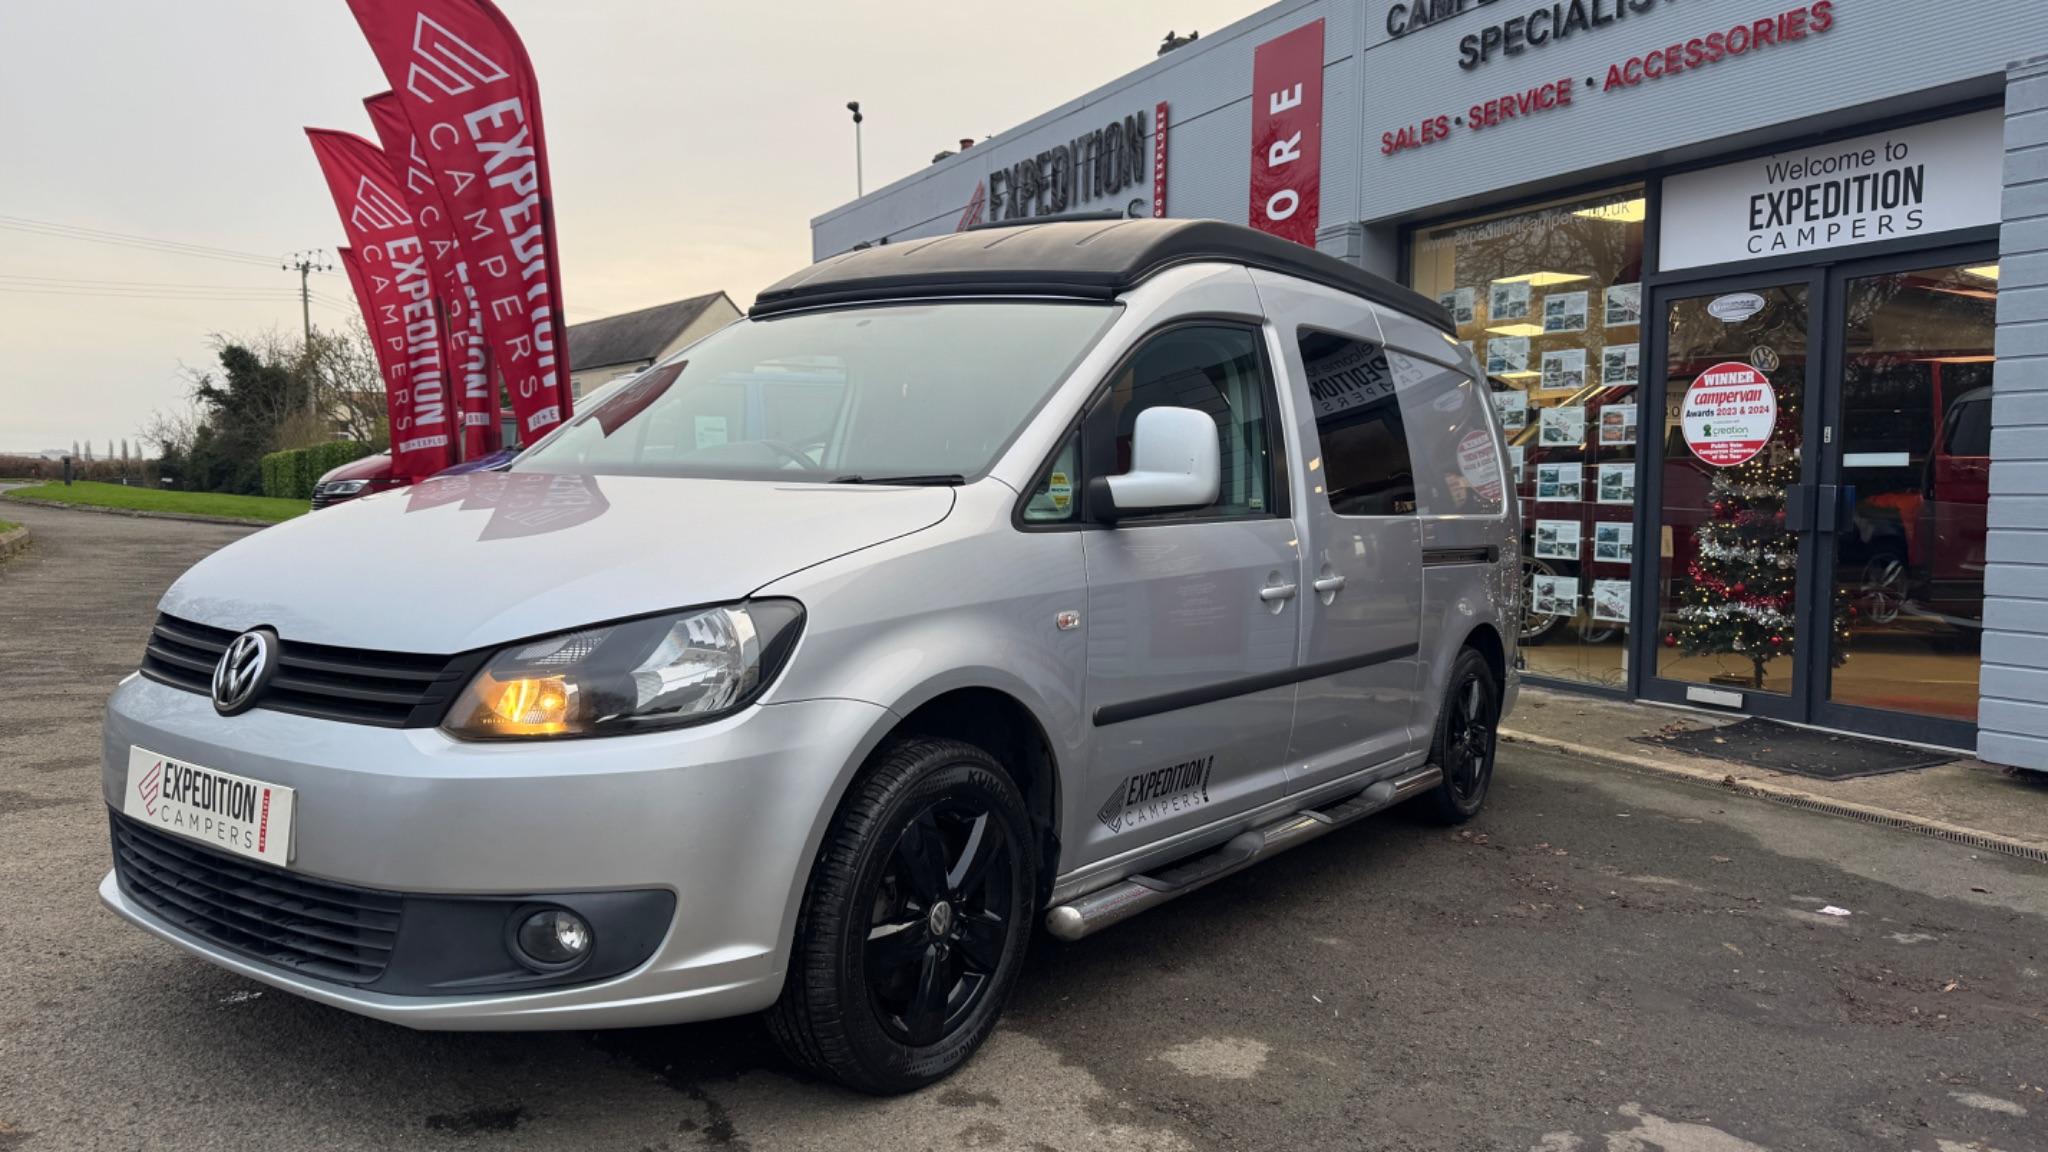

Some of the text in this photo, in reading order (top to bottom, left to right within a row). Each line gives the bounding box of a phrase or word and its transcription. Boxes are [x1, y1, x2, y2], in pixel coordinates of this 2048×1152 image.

[1381, 0, 1834, 156] SALES SERVICE ACCESSORIES
[989, 109, 1145, 222] EXPEDITION
[1766, 141, 1909, 185] Welcome to
[1749, 164, 1924, 232] EXPEDITION
[1747, 209, 1923, 254] CAMPERS
[429, 122, 538, 398] CAMPERS
[363, 244, 412, 430] CAMPERS
[385, 236, 446, 426] EXPEDITION
[1694, 389, 1762, 407] campervan
[1703, 371, 1755, 386] WINNER
[1686, 408, 1715, 418] Awards
[1716, 407, 1737, 416] 2023
[1739, 407, 1746, 415] &
[1747, 405, 1770, 415] 2024
[1713, 426, 1749, 435] creation
[162, 762, 257, 823] EXPEDITION
[1126, 758, 1206, 806] EXPEDITION
[161, 805, 252, 849] CAMPERS
[1124, 791, 1200, 826] CAMPERS
